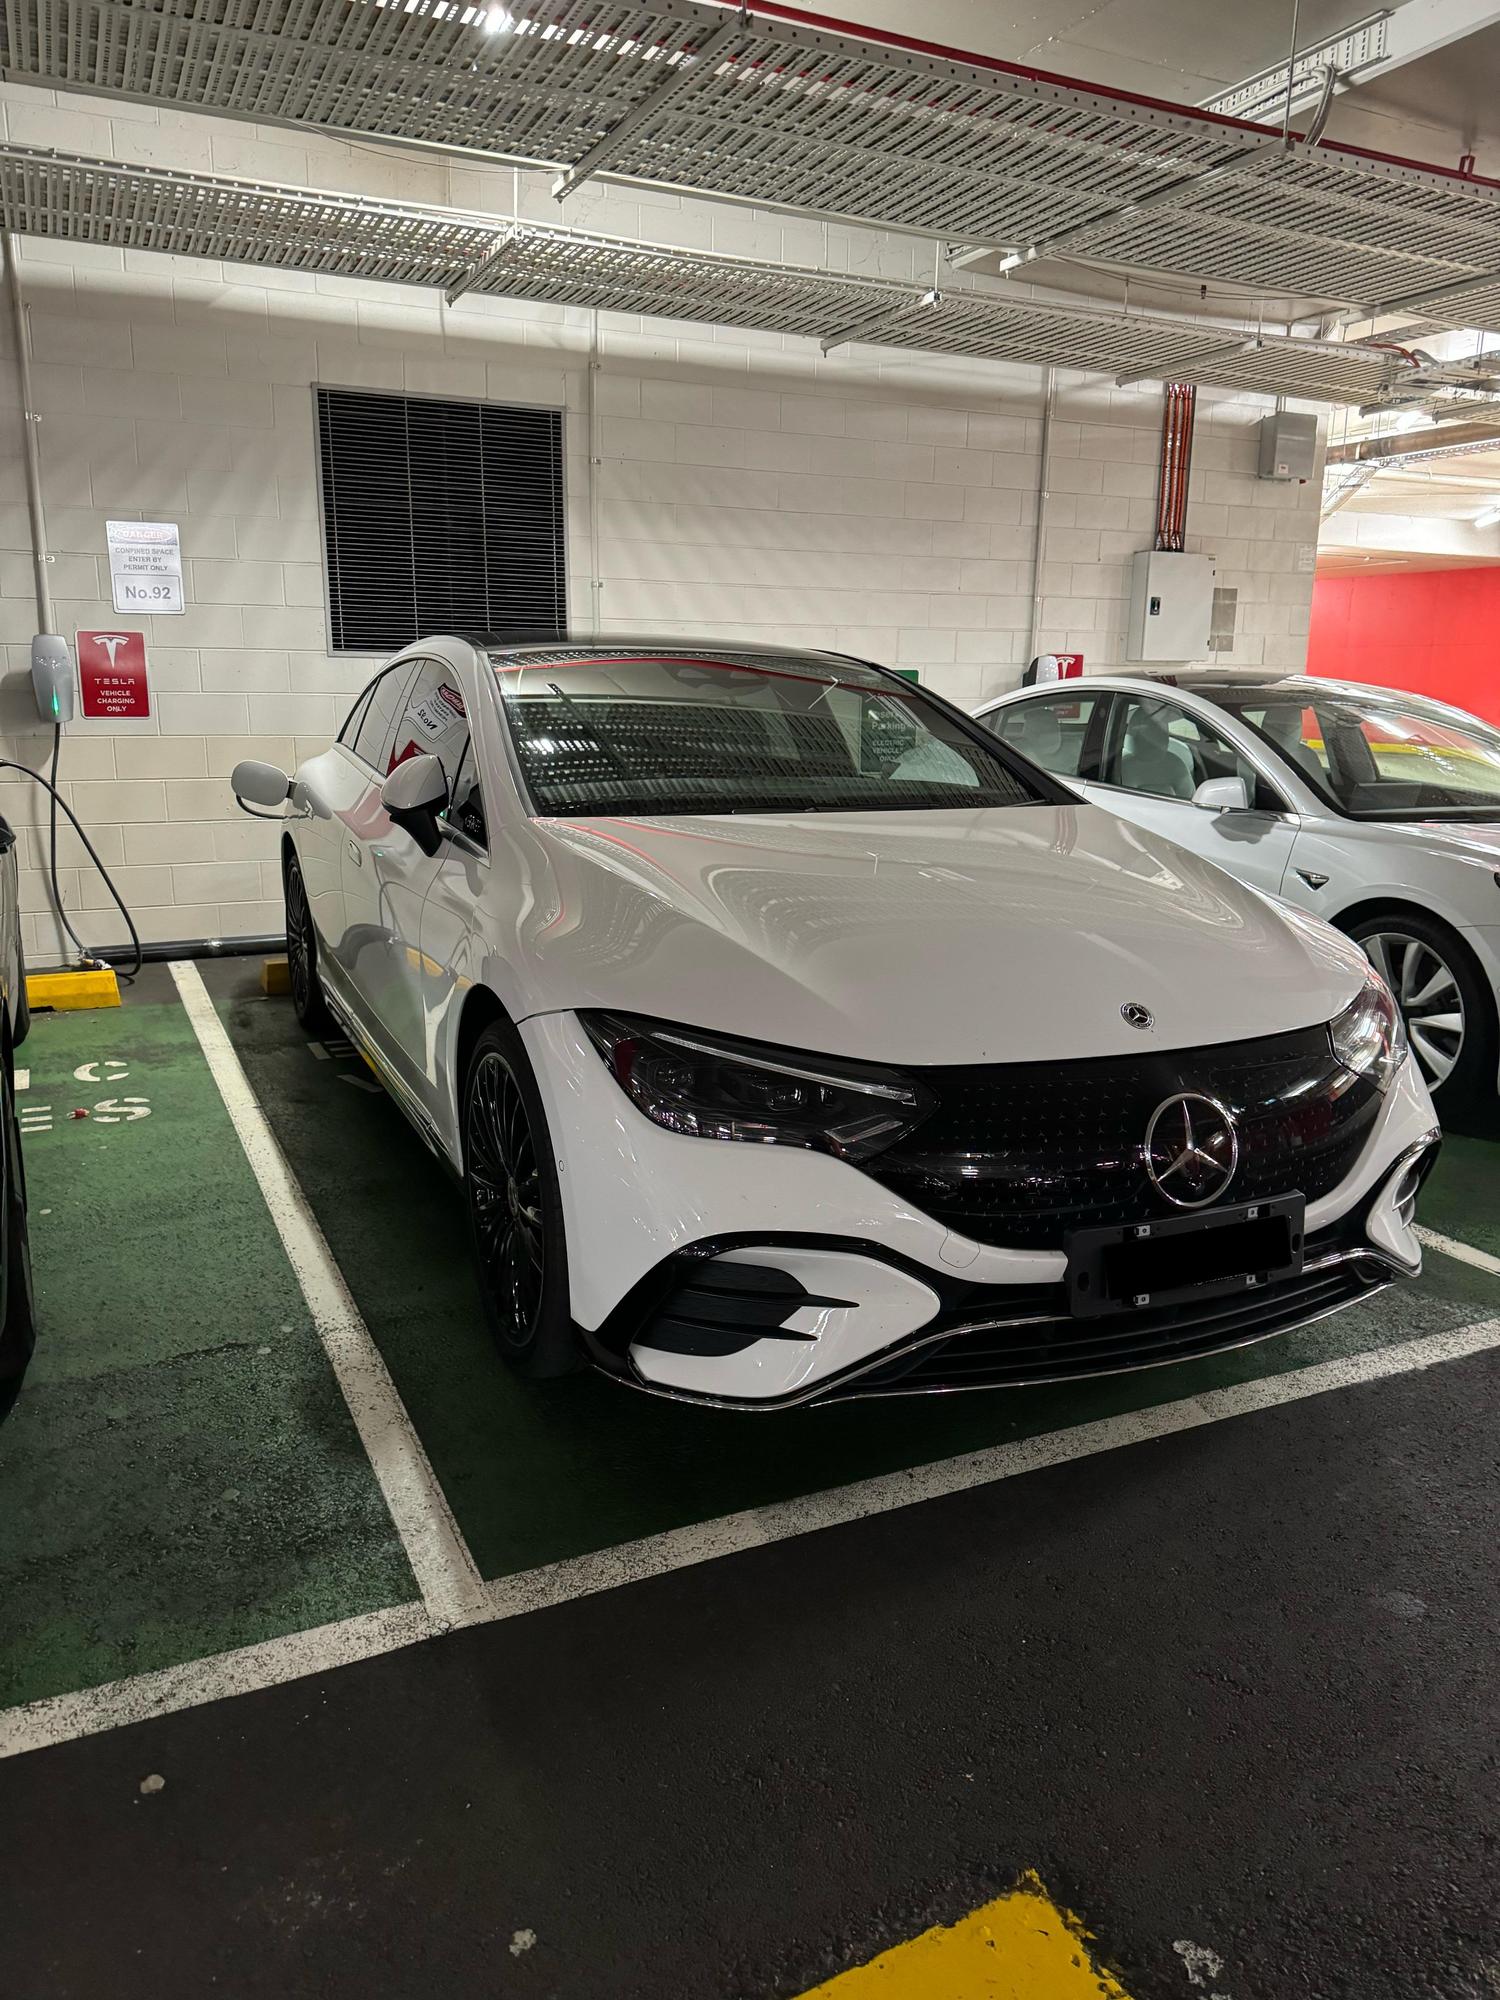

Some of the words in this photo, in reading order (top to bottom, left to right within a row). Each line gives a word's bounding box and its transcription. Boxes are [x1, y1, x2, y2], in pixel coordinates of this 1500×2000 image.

[115, 547, 150, 555] CONFINED
[151, 548, 174, 556] SPACE
[125, 585, 171, 599] No.92
